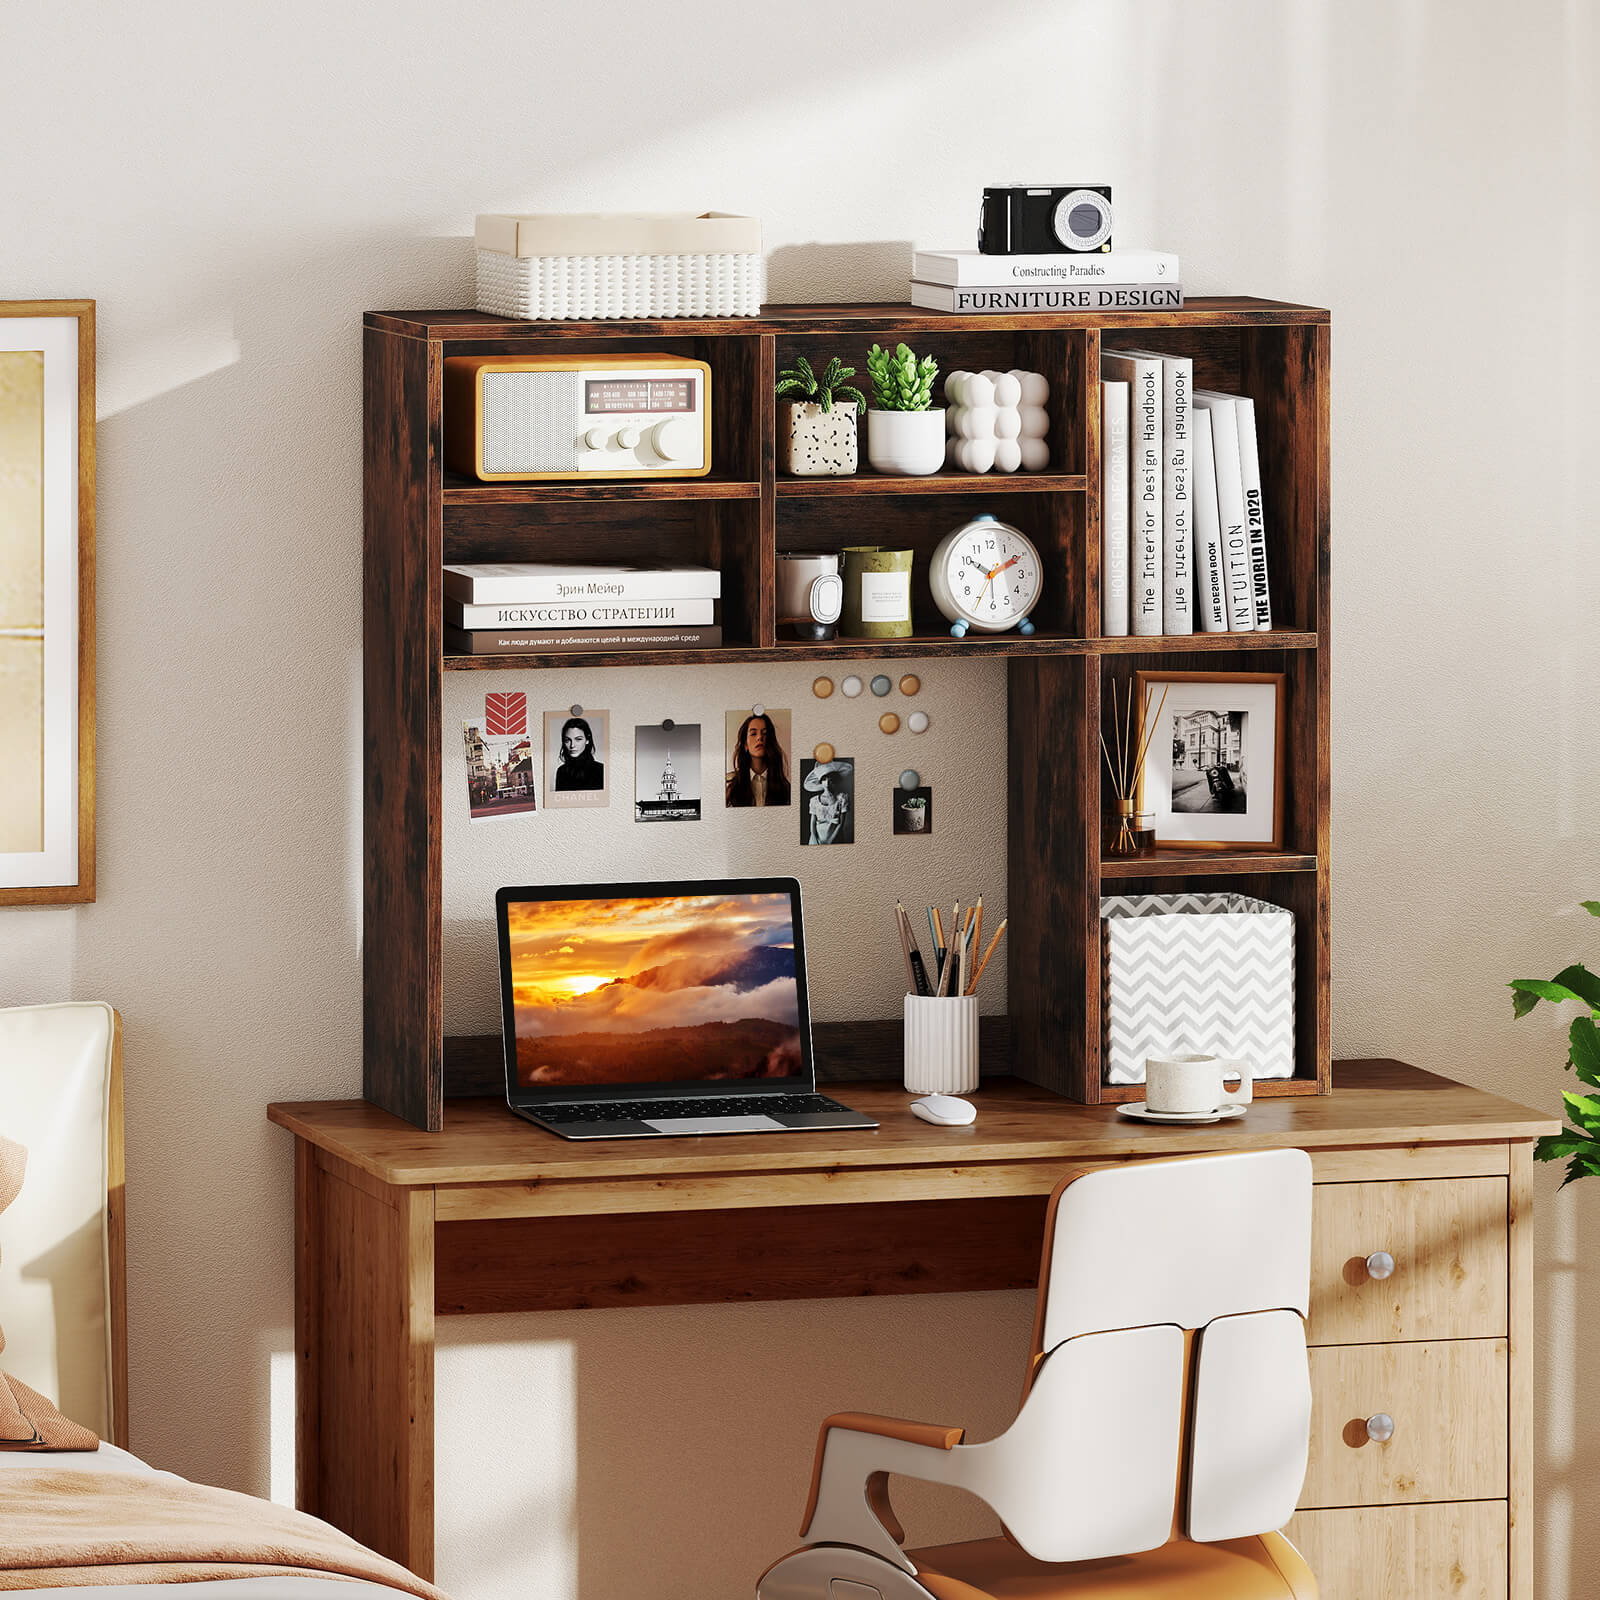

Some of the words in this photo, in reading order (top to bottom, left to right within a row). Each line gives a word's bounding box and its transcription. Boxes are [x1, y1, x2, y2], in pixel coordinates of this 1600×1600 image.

[1012, 264, 1067, 279] Constructing
[1069, 264, 1106, 276] Paradies
[958, 291, 1091, 309] FURNITURE
[1098, 289, 1181, 307] DESIGN
[1142, 371, 1155, 441] Handbook
[1112, 416, 1124, 502] DECORATES
[1142, 449, 1158, 501] Design
[1246, 489, 1262, 526] 2020
[1250, 529, 1263, 544] IN
[972, 545, 981, 554] 11
[984, 540, 995, 550] 12
[1002, 544, 1007, 553] 1
[1142, 510, 1155, 580] Interior
[961, 555, 972, 566] 10
[1112, 511, 1124, 599] HOUSEHOLD
[958, 571, 965, 580] 9
[1018, 569, 1025, 579] 3
[1228, 525, 1250, 625] INTUITION
[1251, 546, 1268, 597] WORLD
[556, 584, 585, 597] Эрин
[587, 583, 625, 596] Мейер
[964, 586, 971, 596] 8
[1013, 585, 1020, 594] 4
[989, 600, 997, 610] 6
[1003, 596, 1010, 605] 5
[1142, 588, 1155, 615] The
[498, 609, 588, 622] ИСКУССТВО
[592, 607, 676, 620] СТРАТЕГИИ
[1256, 600, 1270, 625] THE
[510, 639, 529, 647] люди
[529, 638, 555, 647] думают
[561, 637, 600, 647] добиваются
[601, 636, 621, 645] целей
[627, 634, 679, 644] международной
[680, 634, 701, 643] среде
[554, 792, 600, 801] CHANEL
